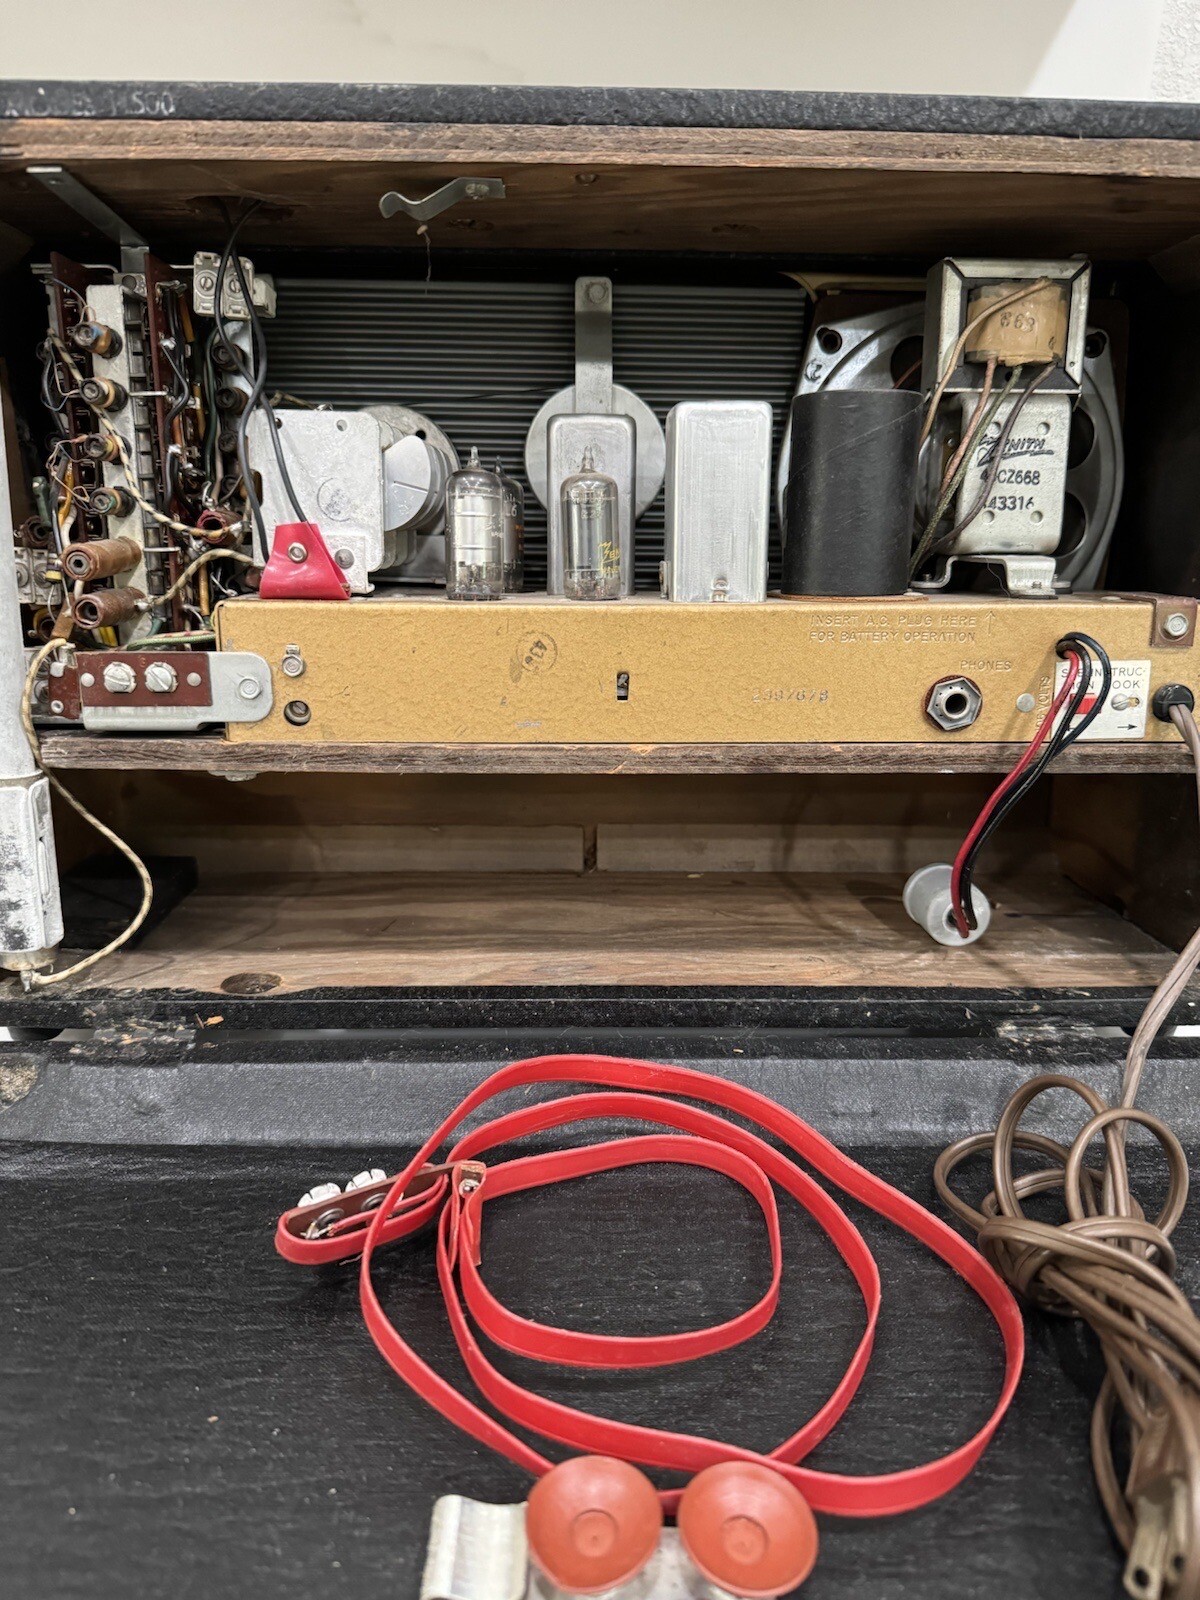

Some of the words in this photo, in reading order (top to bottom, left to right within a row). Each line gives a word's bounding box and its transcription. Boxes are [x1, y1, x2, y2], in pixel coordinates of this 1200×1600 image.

[980, 468, 1041, 486] 4CZ668
[810, 614, 859, 627] INSERT
[899, 615, 933, 628] PLUG
[940, 616, 977, 628] HERE
[809, 630, 836, 643] FOR
[840, 630, 899, 643] BATTERY
[903, 631, 976, 644] OPERATION
[960, 660, 1012, 672] PHONES
